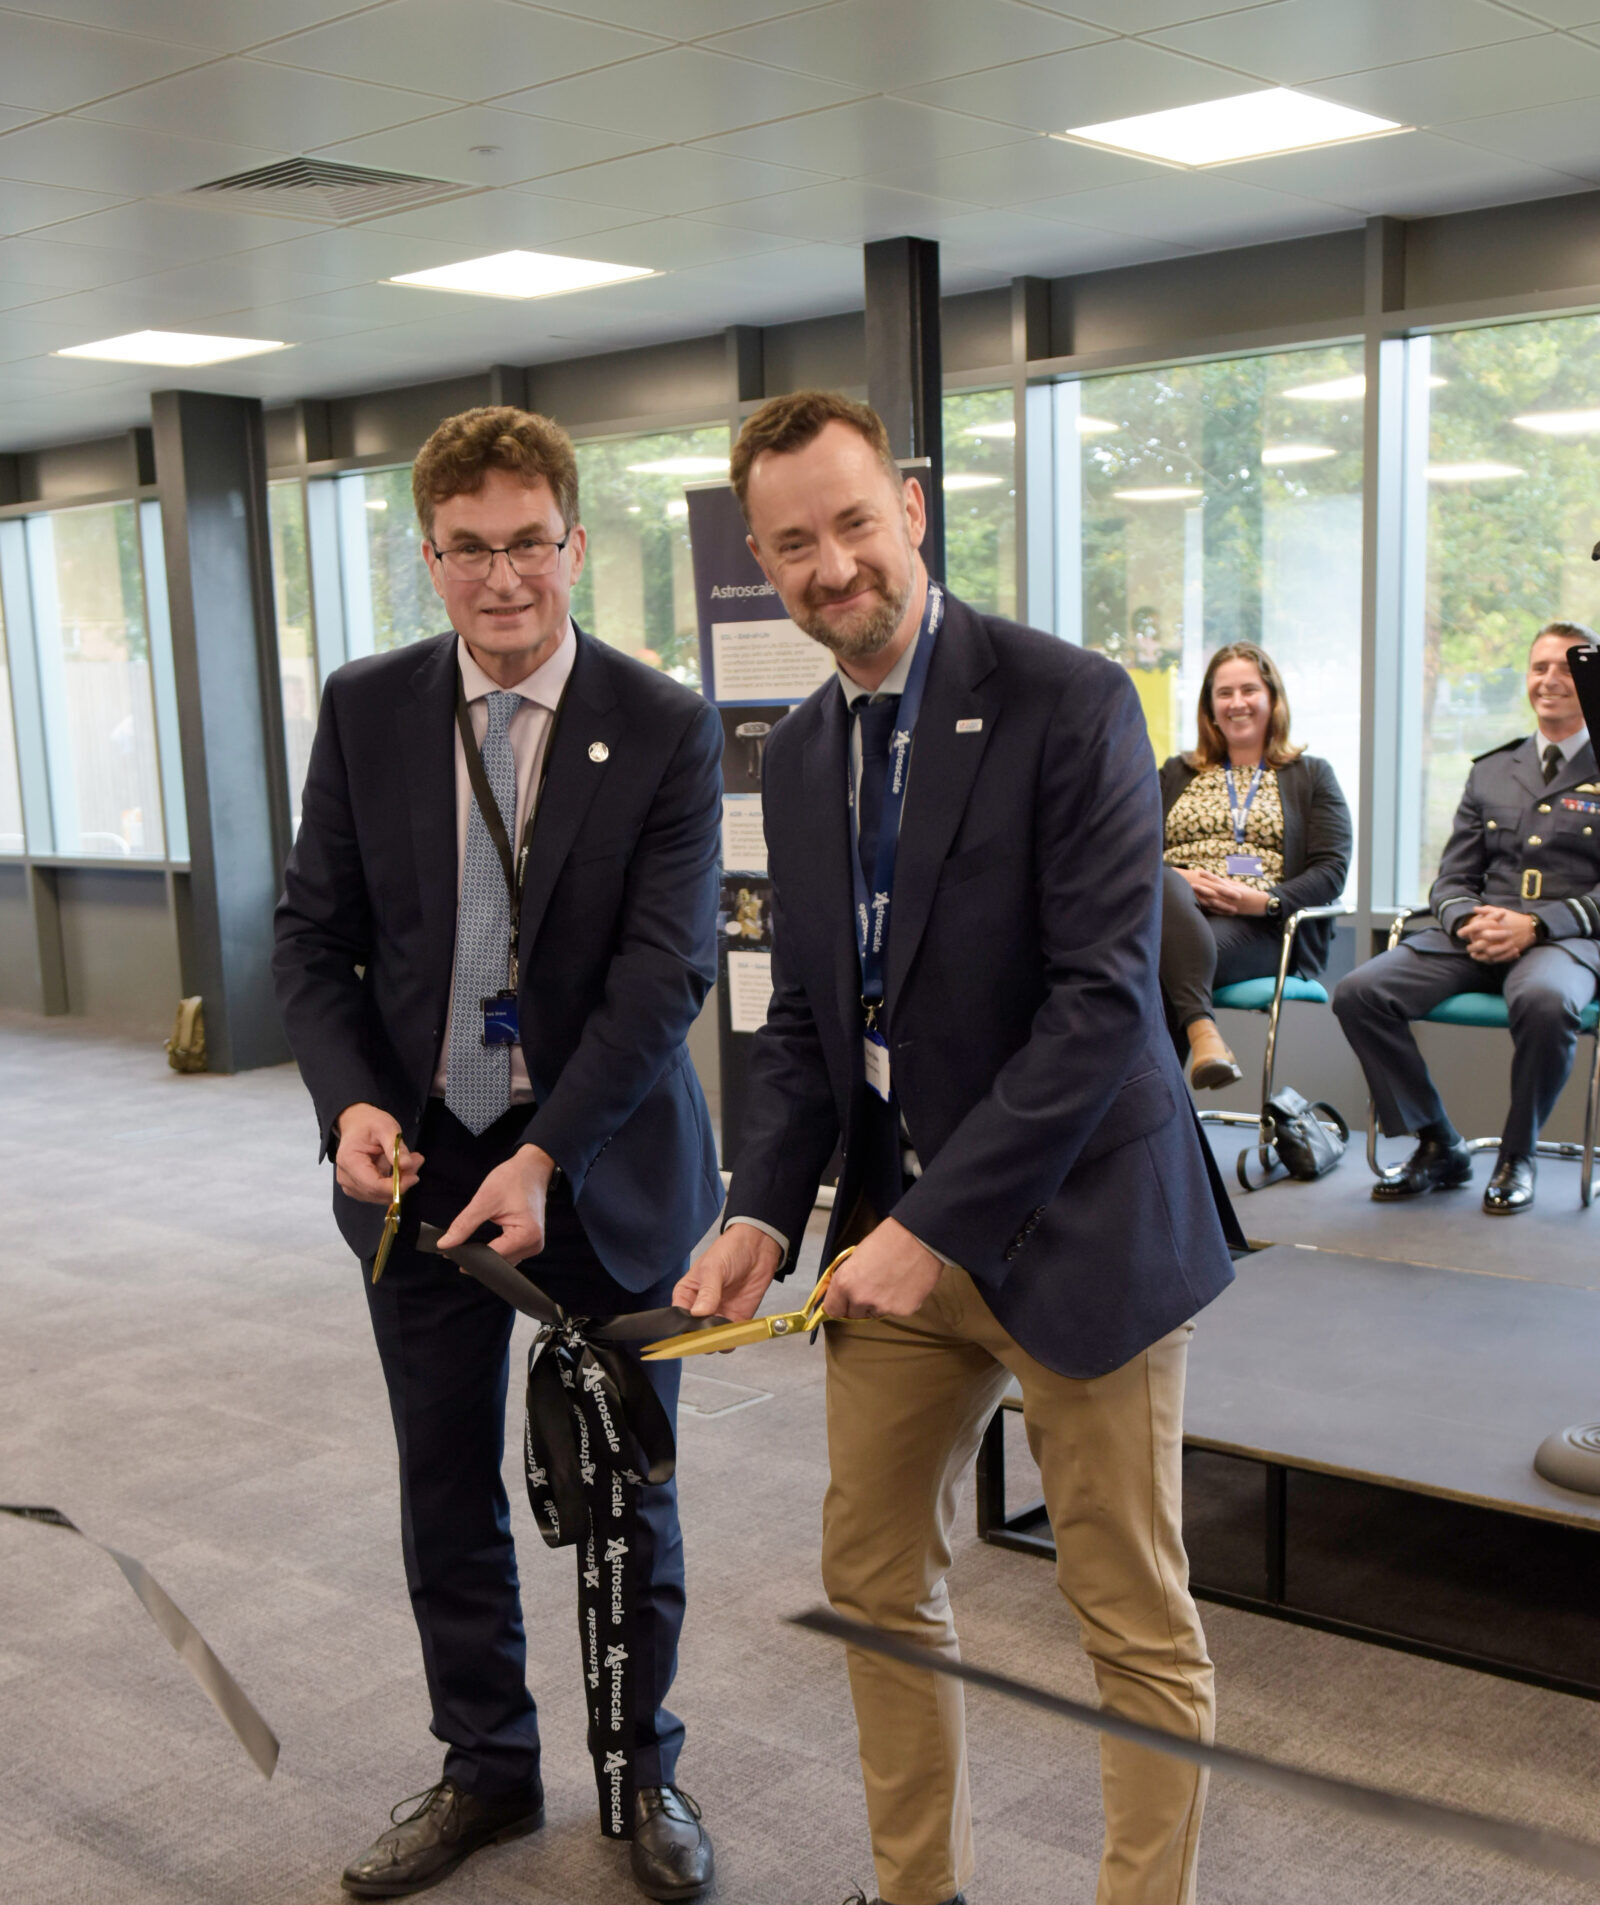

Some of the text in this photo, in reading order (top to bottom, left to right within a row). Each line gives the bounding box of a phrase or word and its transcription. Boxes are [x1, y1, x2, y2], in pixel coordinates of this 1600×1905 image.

[711, 581, 776, 599] Astroscale
[893, 730, 910, 794] Astroscale
[872, 892, 890, 953] Astroscale
[572, 1404, 597, 1486] Astroscale
[582, 1361, 620, 1453] Astroscale
[612, 1470, 625, 1518] scale
[583, 1506, 600, 1588] Astros
[604, 1537, 629, 1625] Astroscale
[586, 1607, 599, 1689] Astroscale
[604, 1643, 629, 1732] Astroscale
[603, 1750, 628, 1833] Astroscale
